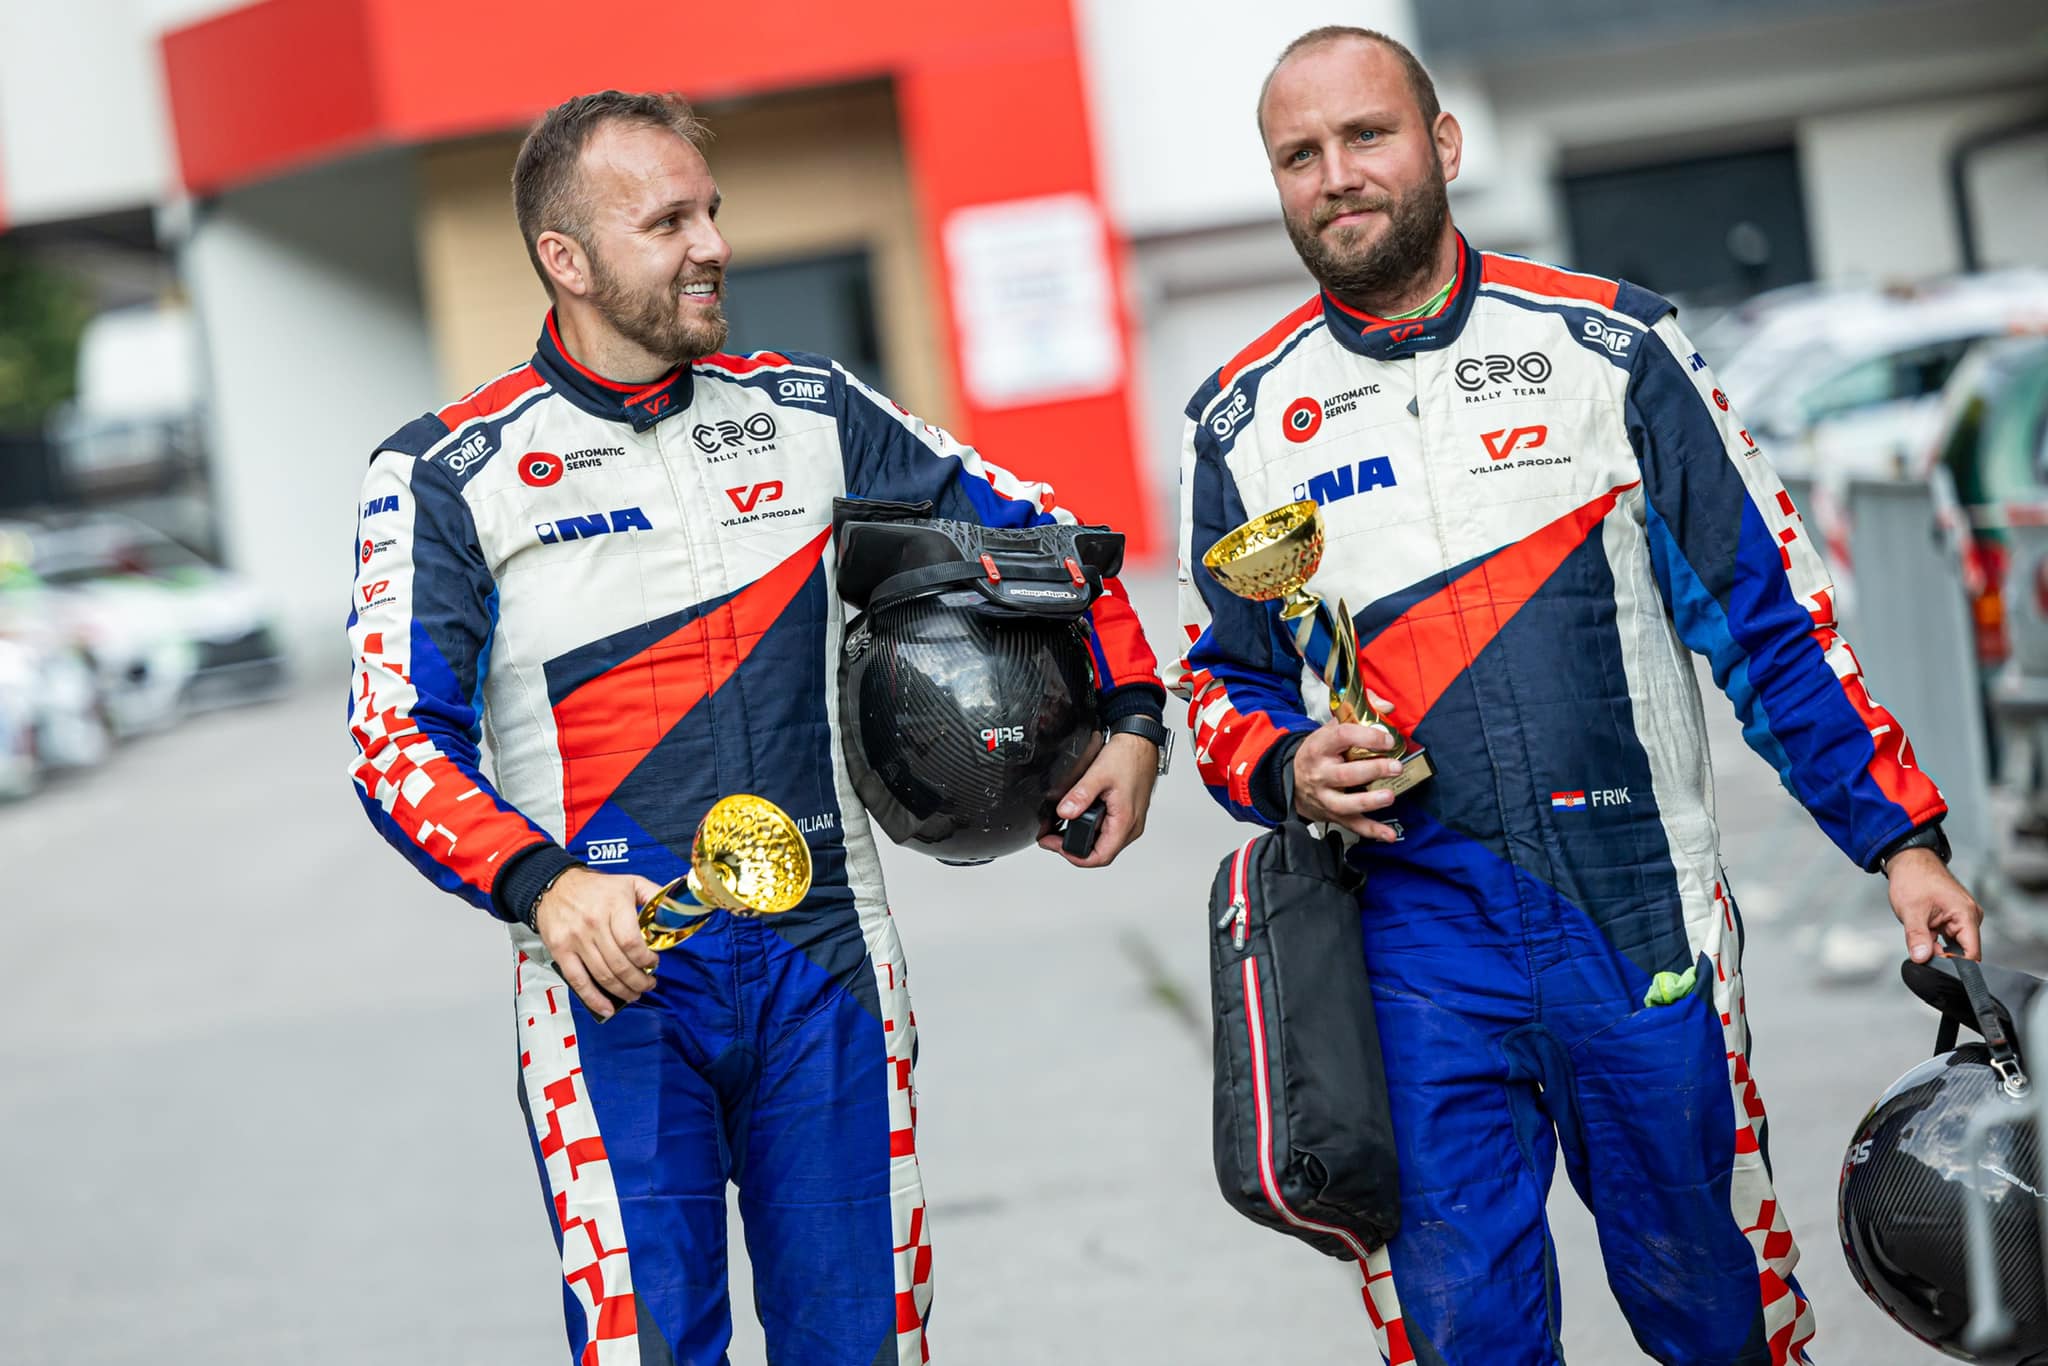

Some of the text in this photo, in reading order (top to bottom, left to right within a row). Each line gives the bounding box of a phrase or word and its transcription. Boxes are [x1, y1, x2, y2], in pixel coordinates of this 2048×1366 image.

[1584, 321, 1631, 351] OMP
[1455, 351, 1552, 391] CRO
[779, 382, 826, 398] OMP
[1324, 384, 1381, 409] AUTOMATIC
[1465, 387, 1546, 404] RALLY TEAM
[1213, 393, 1248, 435] OMP
[1325, 401, 1357, 420] SERVIS
[692, 412, 777, 454] CRO
[449, 435, 487, 471] OMP
[564, 447, 626, 462] AUTOMATIC
[707, 443, 776, 464] RALLY TEAM
[567, 458, 602, 471] SERVIS
[1469, 456, 1572, 475] VILIAM PRODAN
[721, 507, 805, 527] VILIAM PRODAN
[1591, 787, 1631, 807] FRIK
[588, 843, 629, 860] OMP
